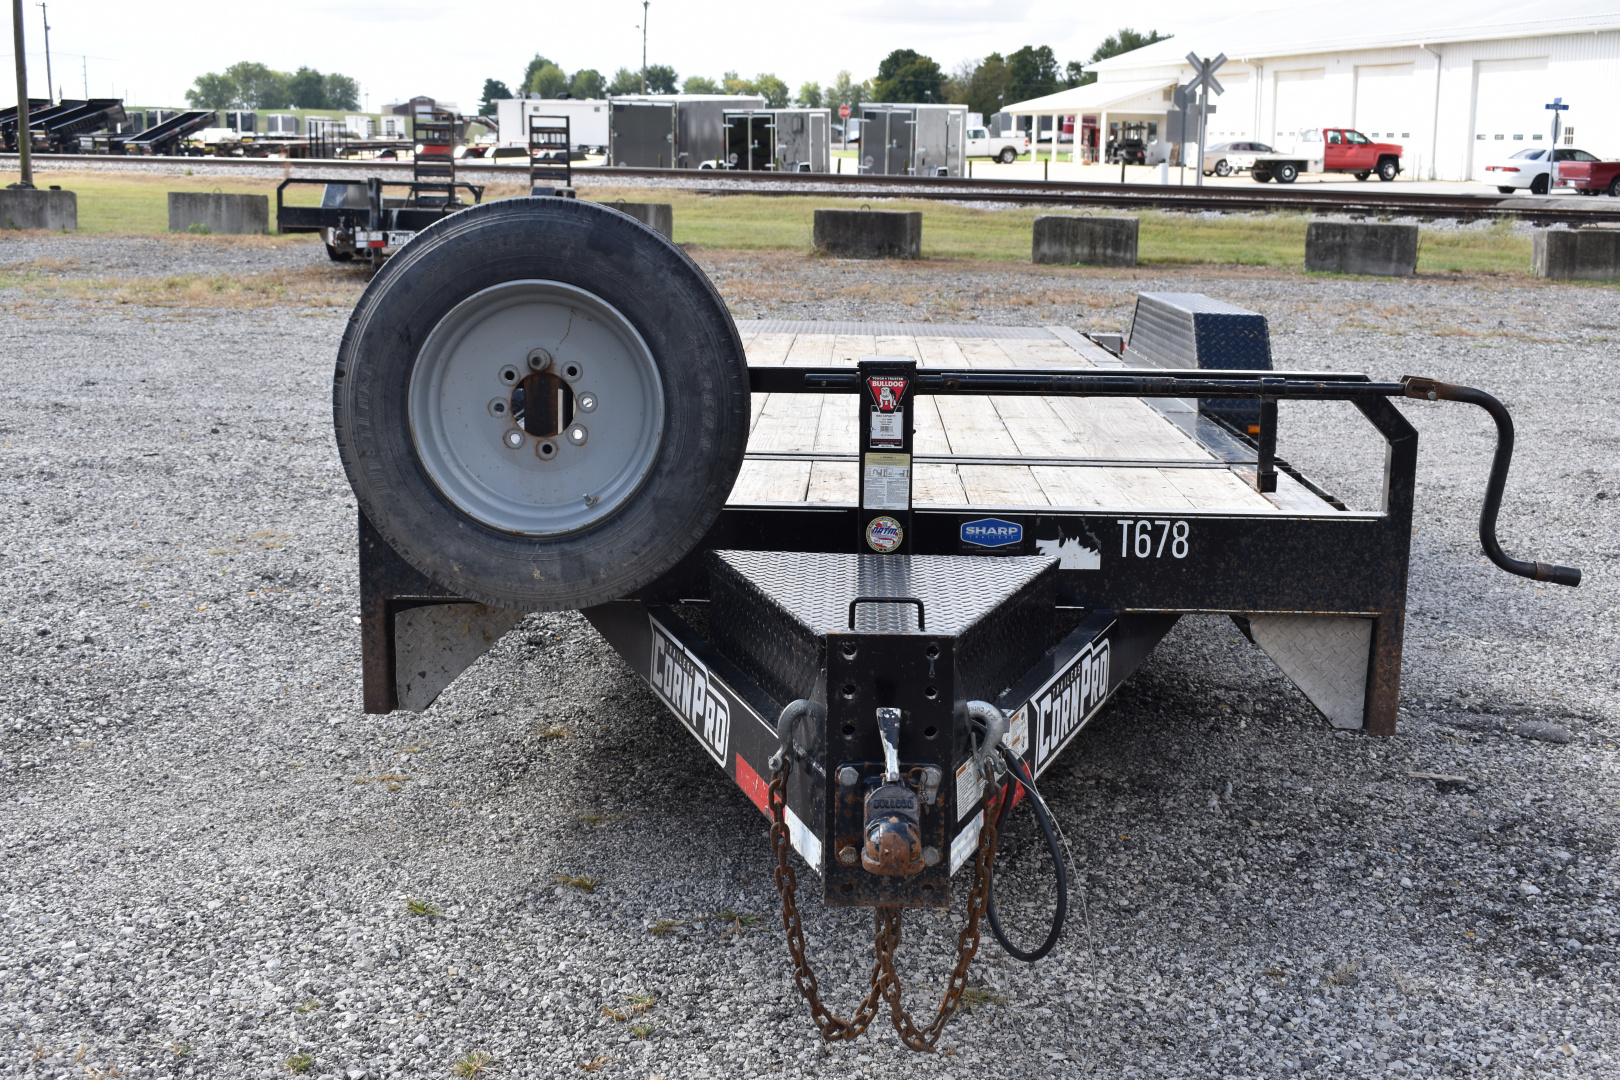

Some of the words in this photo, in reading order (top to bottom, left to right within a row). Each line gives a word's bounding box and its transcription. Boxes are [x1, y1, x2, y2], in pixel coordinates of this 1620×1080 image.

[965, 526, 1018, 535] SHARP
[1117, 519, 1189, 559] T678
[666, 641, 694, 676] TRAILERS
[1052, 663, 1081, 699] TRAILERS
[873, 799, 914, 809] BULLDOG
